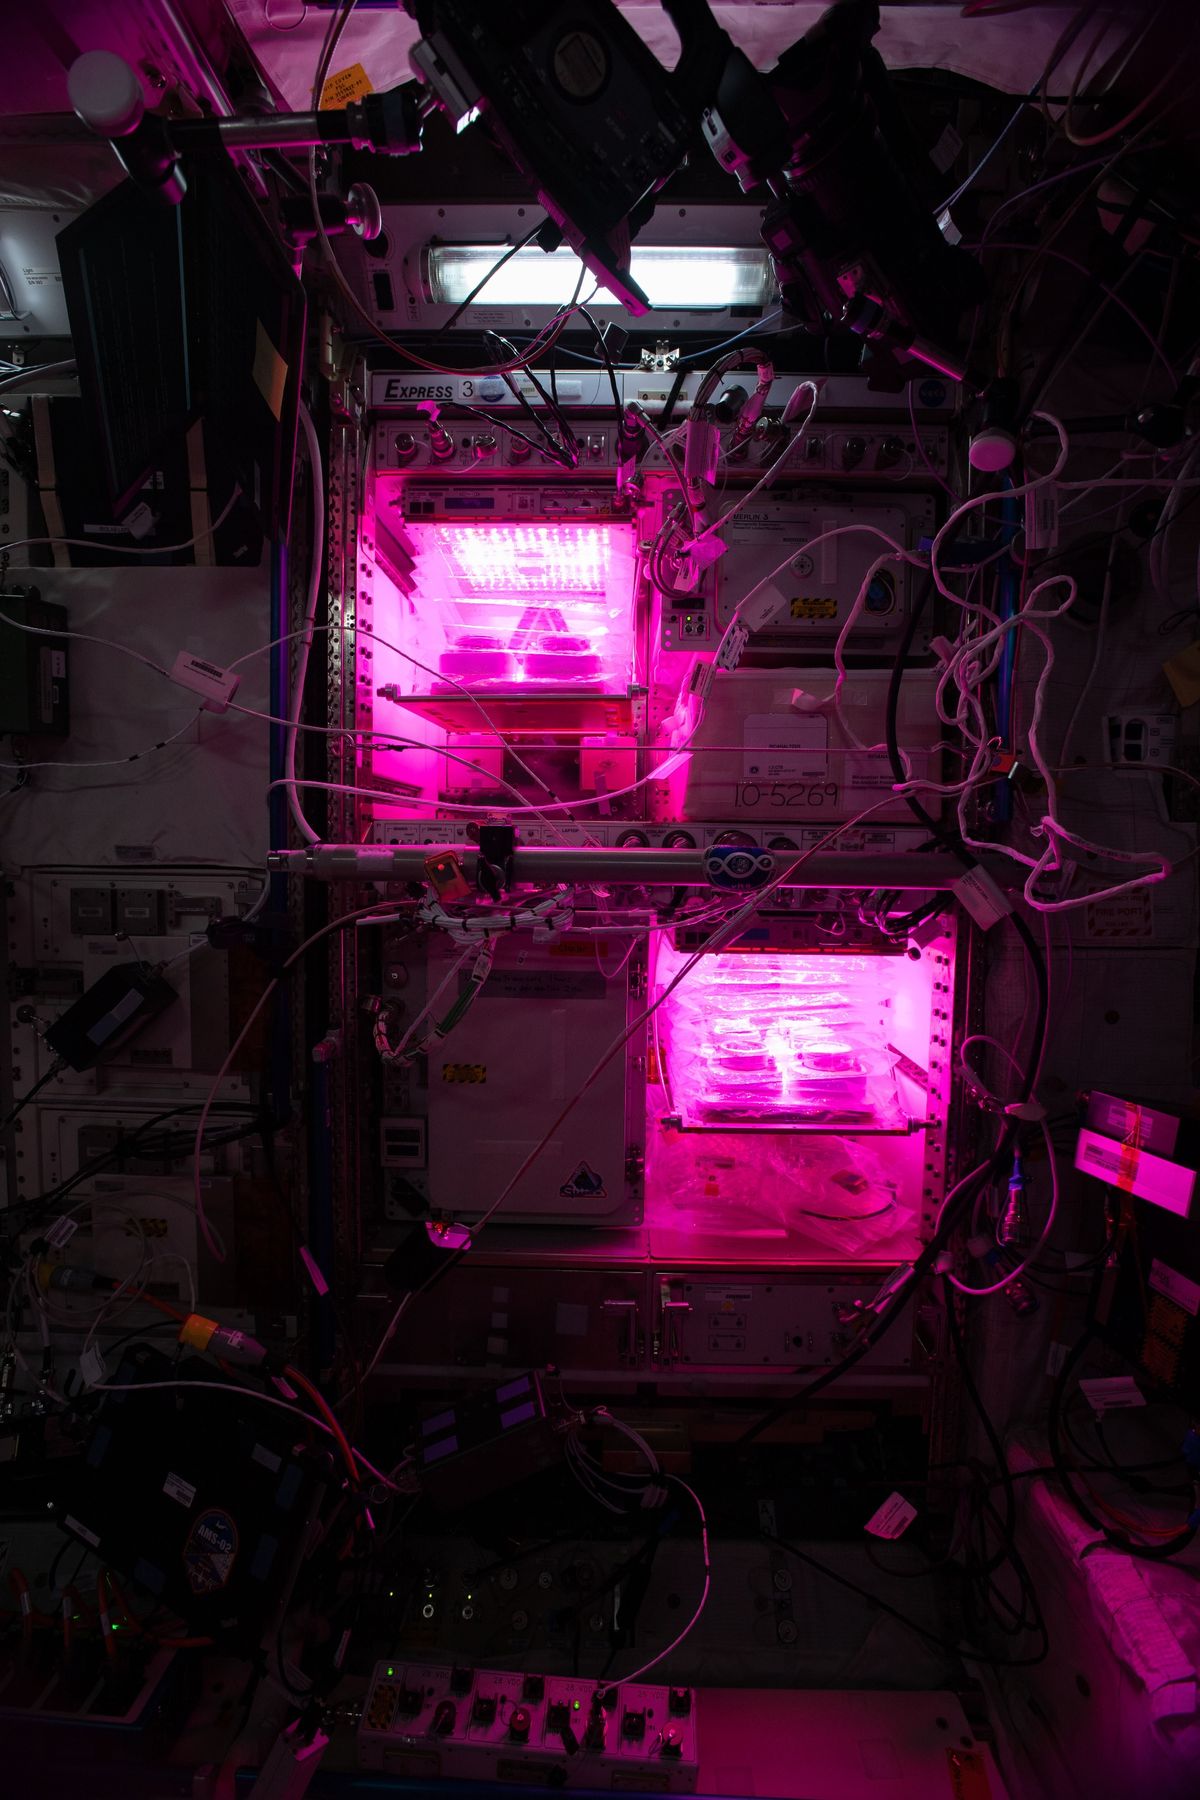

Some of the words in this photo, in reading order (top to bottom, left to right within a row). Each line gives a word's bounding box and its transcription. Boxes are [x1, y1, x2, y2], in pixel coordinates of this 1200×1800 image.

[463, 380, 475, 398] 3
[733, 513, 761, 521] MERLIN
[1117, 908, 1143, 917] PORT
[198, 1523, 232, 1553] AMS-02
